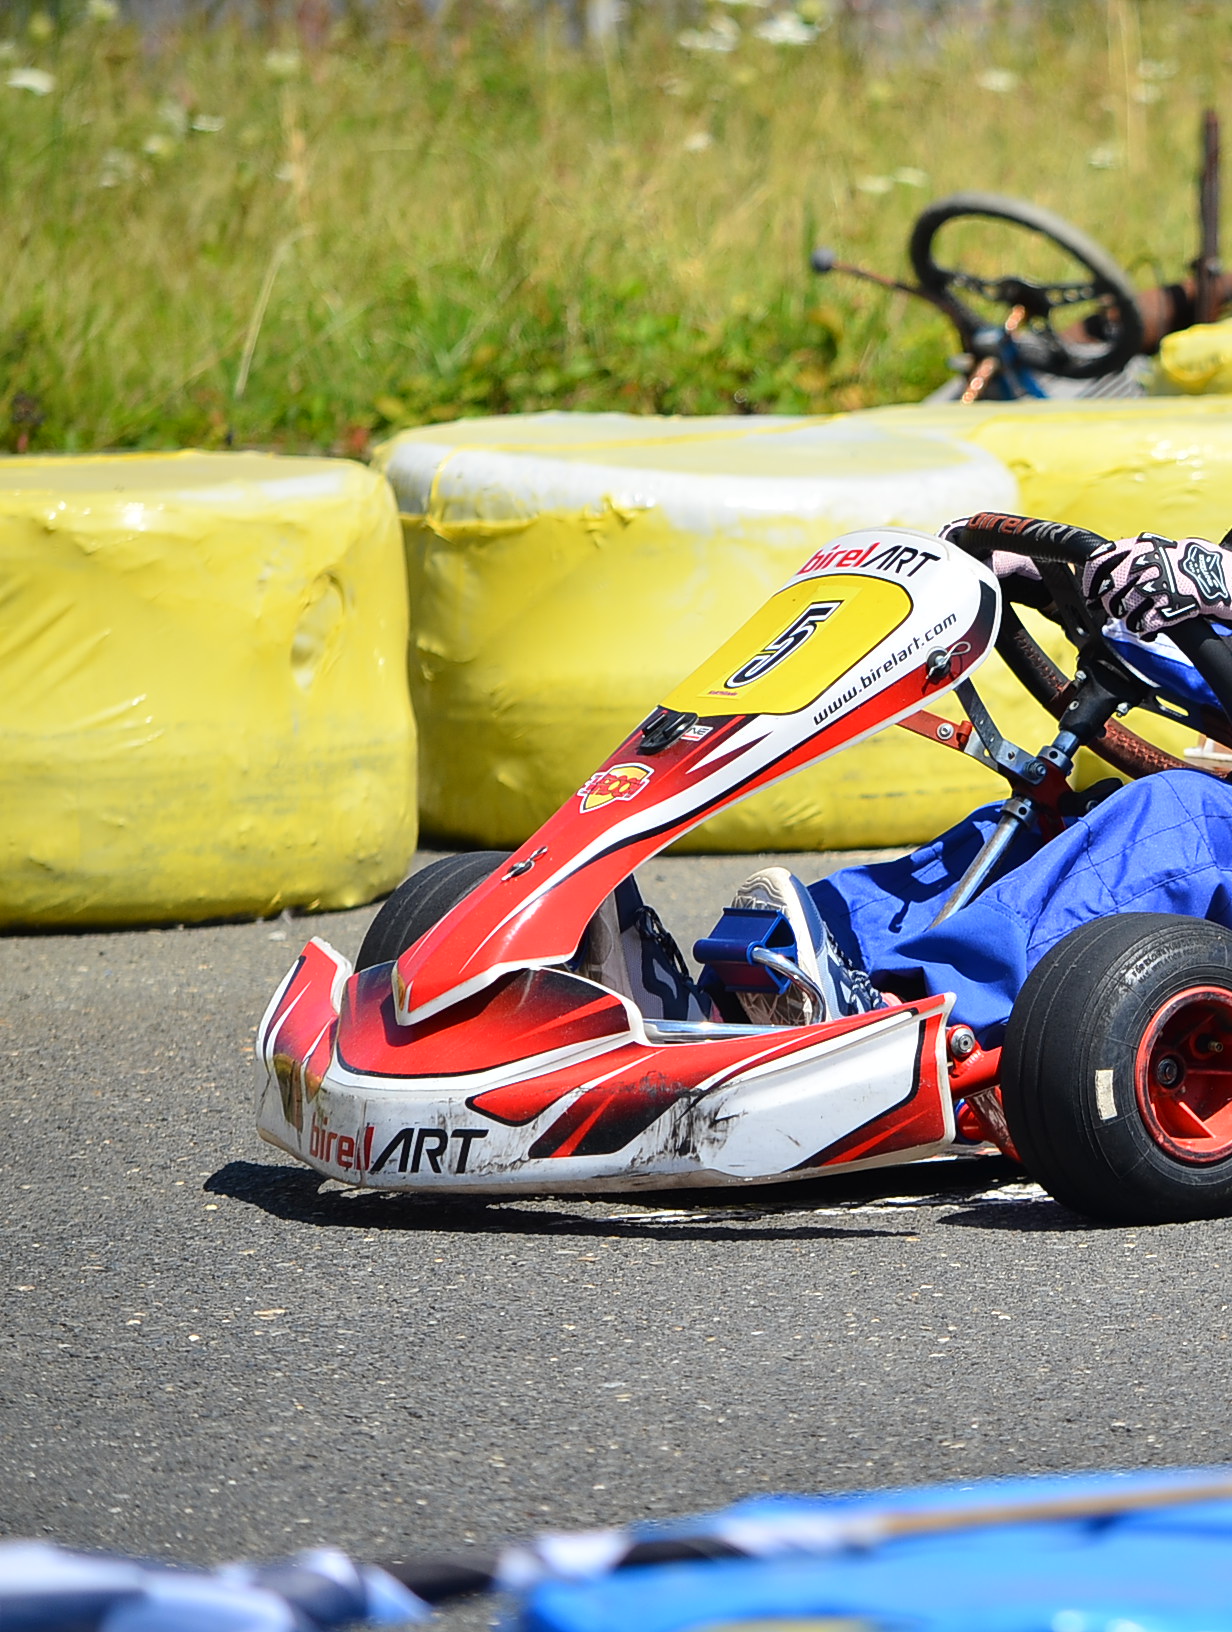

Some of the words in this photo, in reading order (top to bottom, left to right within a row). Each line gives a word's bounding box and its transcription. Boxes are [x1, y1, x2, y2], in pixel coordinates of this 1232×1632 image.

[796, 542, 941, 577] birelART
[723, 599, 845, 689] 5
[813, 613, 957, 726] www.birelart.com
[310, 1111, 489, 1174] birelART
